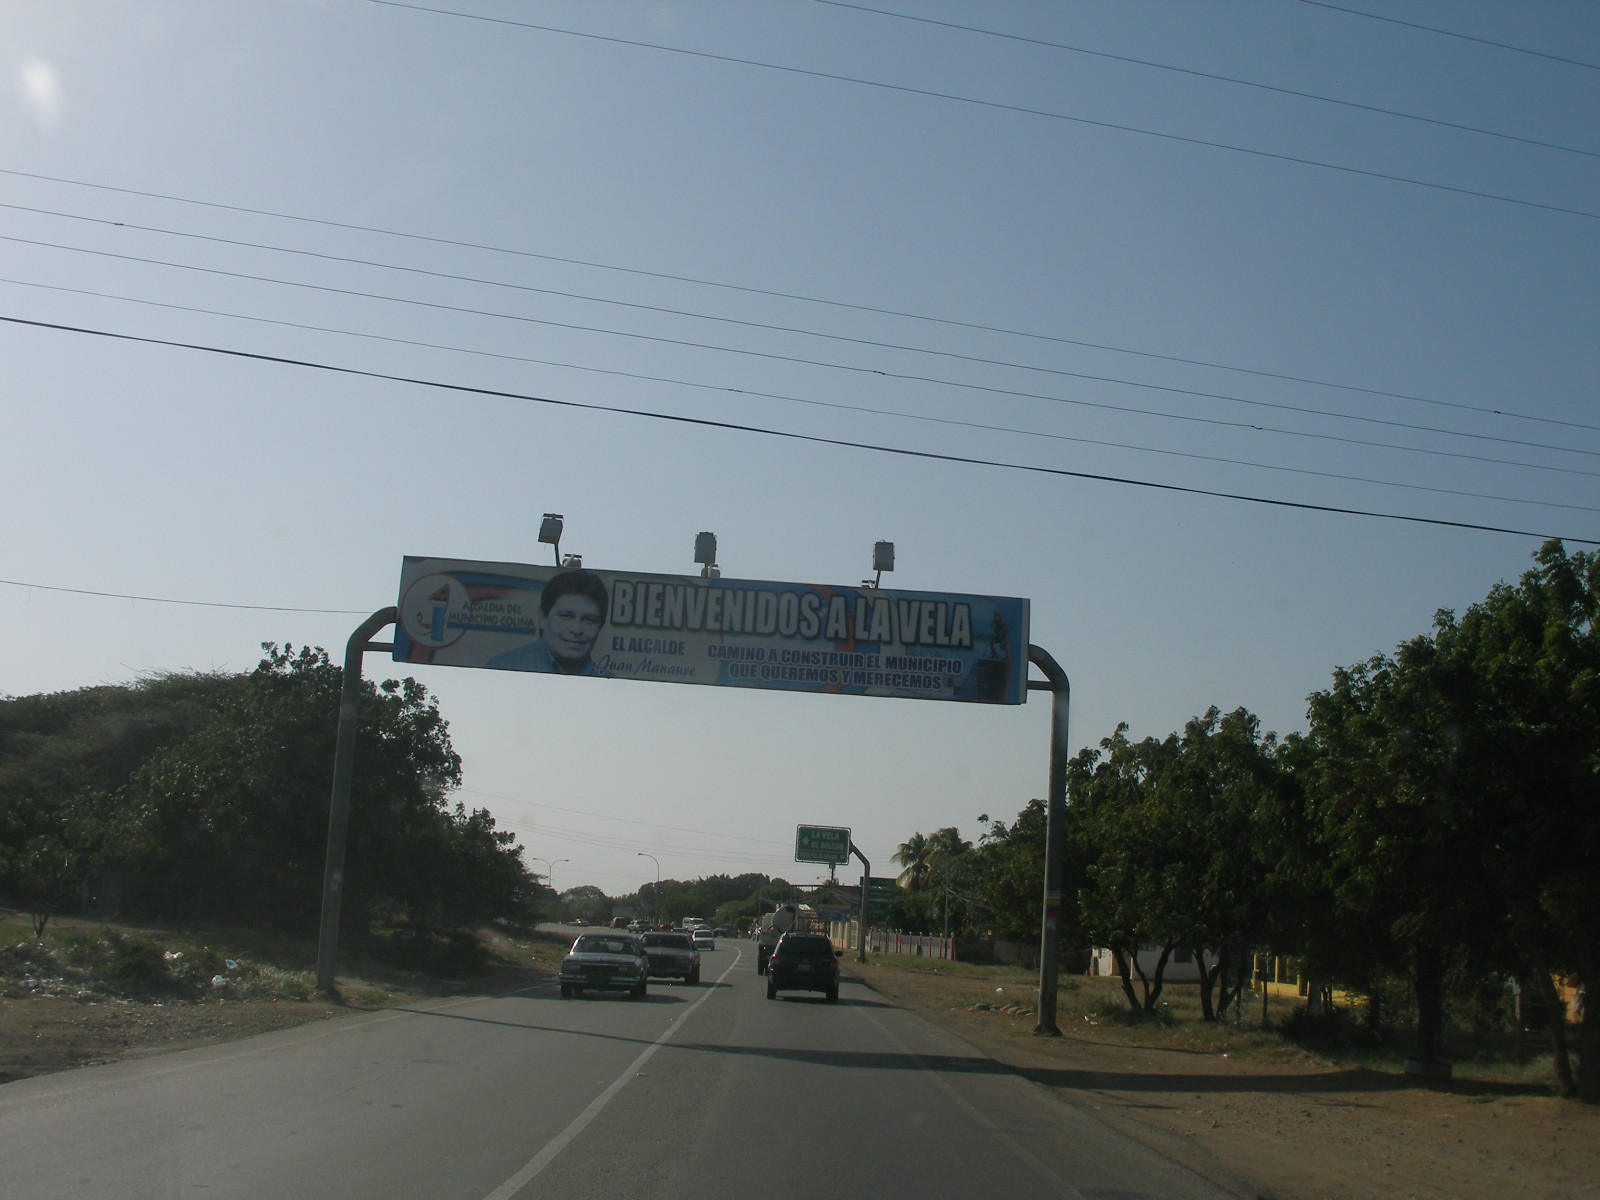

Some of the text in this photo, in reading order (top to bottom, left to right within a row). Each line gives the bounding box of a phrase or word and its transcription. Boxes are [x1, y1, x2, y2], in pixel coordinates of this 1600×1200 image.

[448, 612, 535, 626] MUNICIPIO COLINA
[507, 604, 522, 614] DEL
[611, 580, 972, 648] BIENVENIDOS A LA VELA
[612, 636, 685, 656] EL ALCALDE
[596, 655, 696, 678] Juan Manaure
[707, 645, 962, 674] CAMINO A CONSTRUIR EL MUNICIPIO
[729, 664, 942, 690] QUE QUEREMOS Y MERECEMOS
[822, 831, 840, 840] VELA
